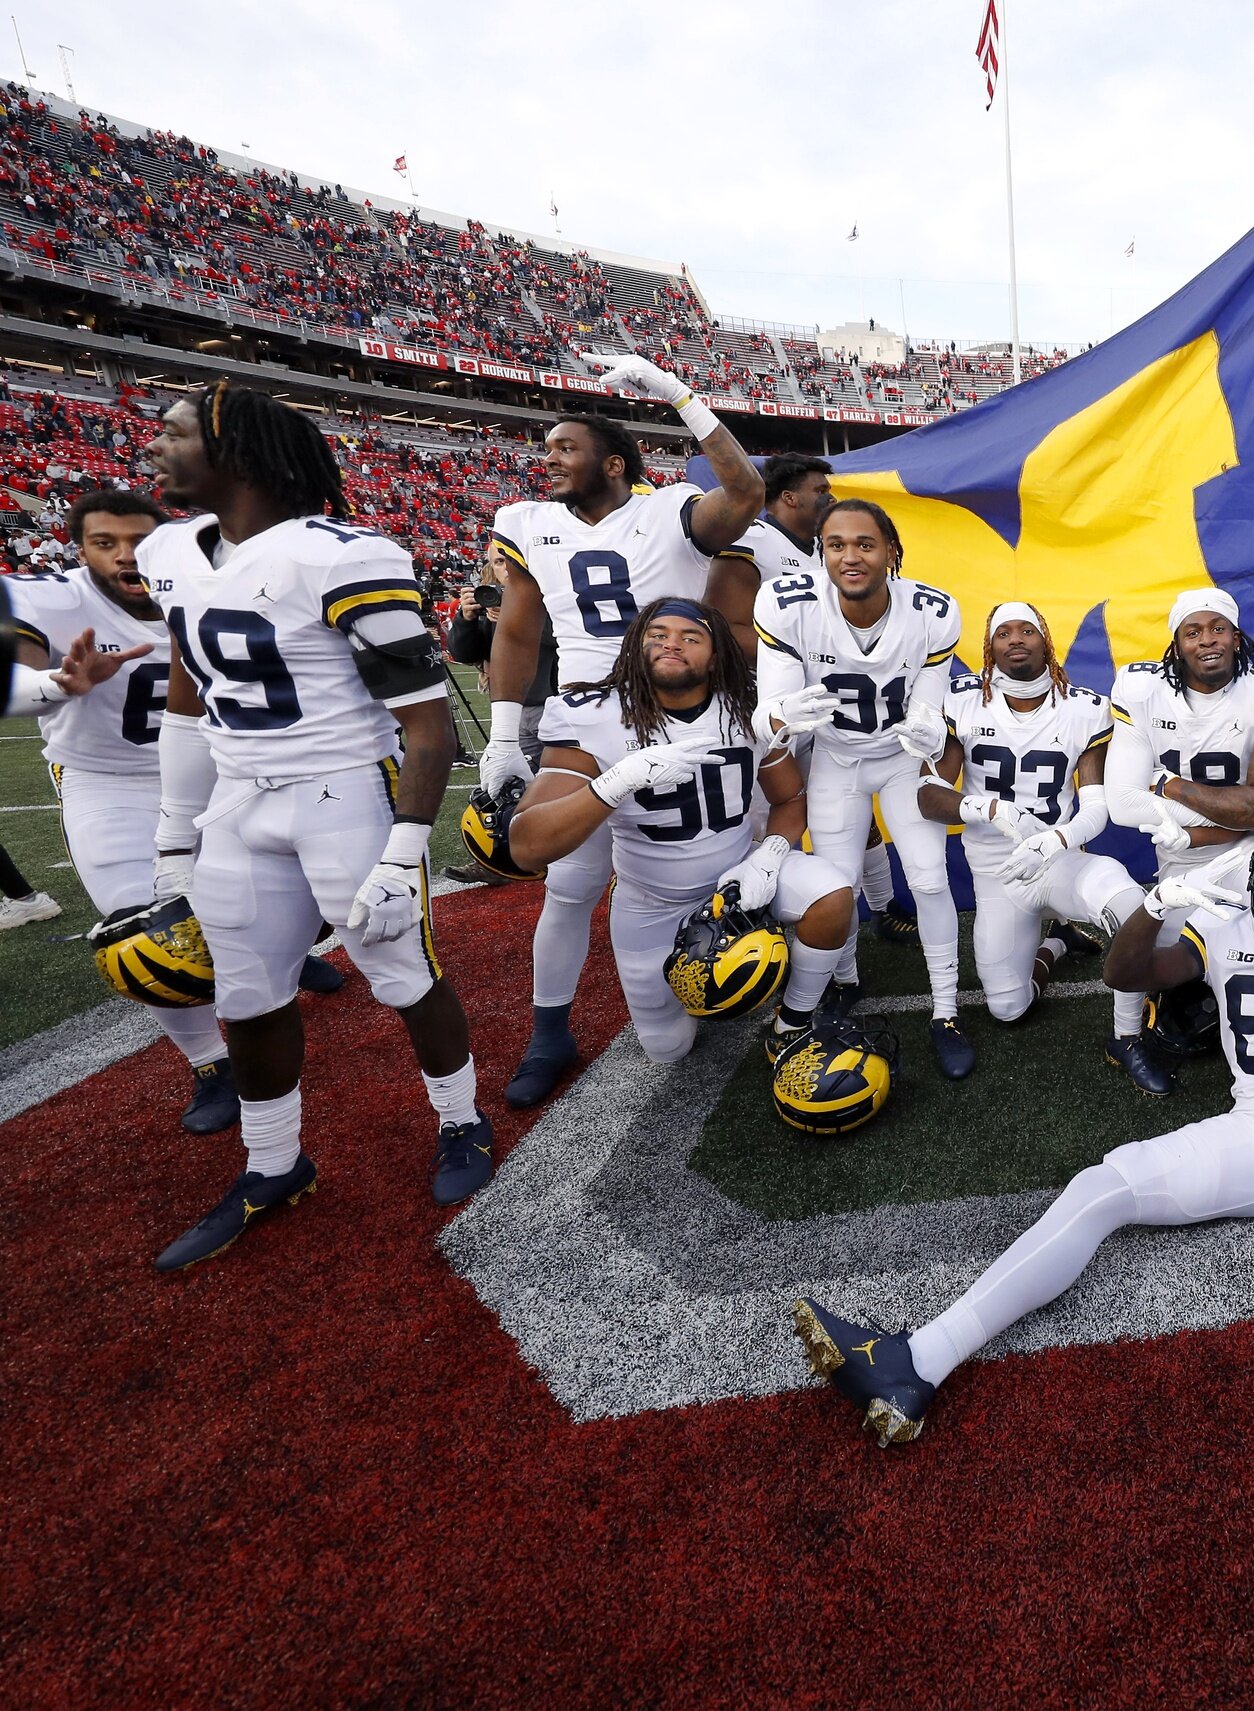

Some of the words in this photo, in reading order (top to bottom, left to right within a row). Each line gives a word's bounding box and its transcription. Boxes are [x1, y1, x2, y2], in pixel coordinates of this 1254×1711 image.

[365, 341, 383, 355] 10
[394, 346, 439, 366] SMITH
[459, 359, 475, 372] 22
[480, 362, 531, 382] HORVATH
[543, 374, 558, 386] 27
[566, 377, 608, 393] GEORGE
[712, 397, 751, 411] CASSADY
[762, 403, 775, 413] 45
[779, 404, 815, 417] GRIFFIN
[826, 410, 838, 419] 47
[843, 411, 876, 422] HARLEY
[904, 415, 935, 425] WILLIS
[569, 550, 638, 637] 8
[772, 574, 818, 610] 31
[912, 583, 951, 618] 31
[167, 606, 304, 730] 19
[821, 673, 906, 734] 31
[634, 746, 754, 842] 90
[971, 744, 1069, 825] 33
